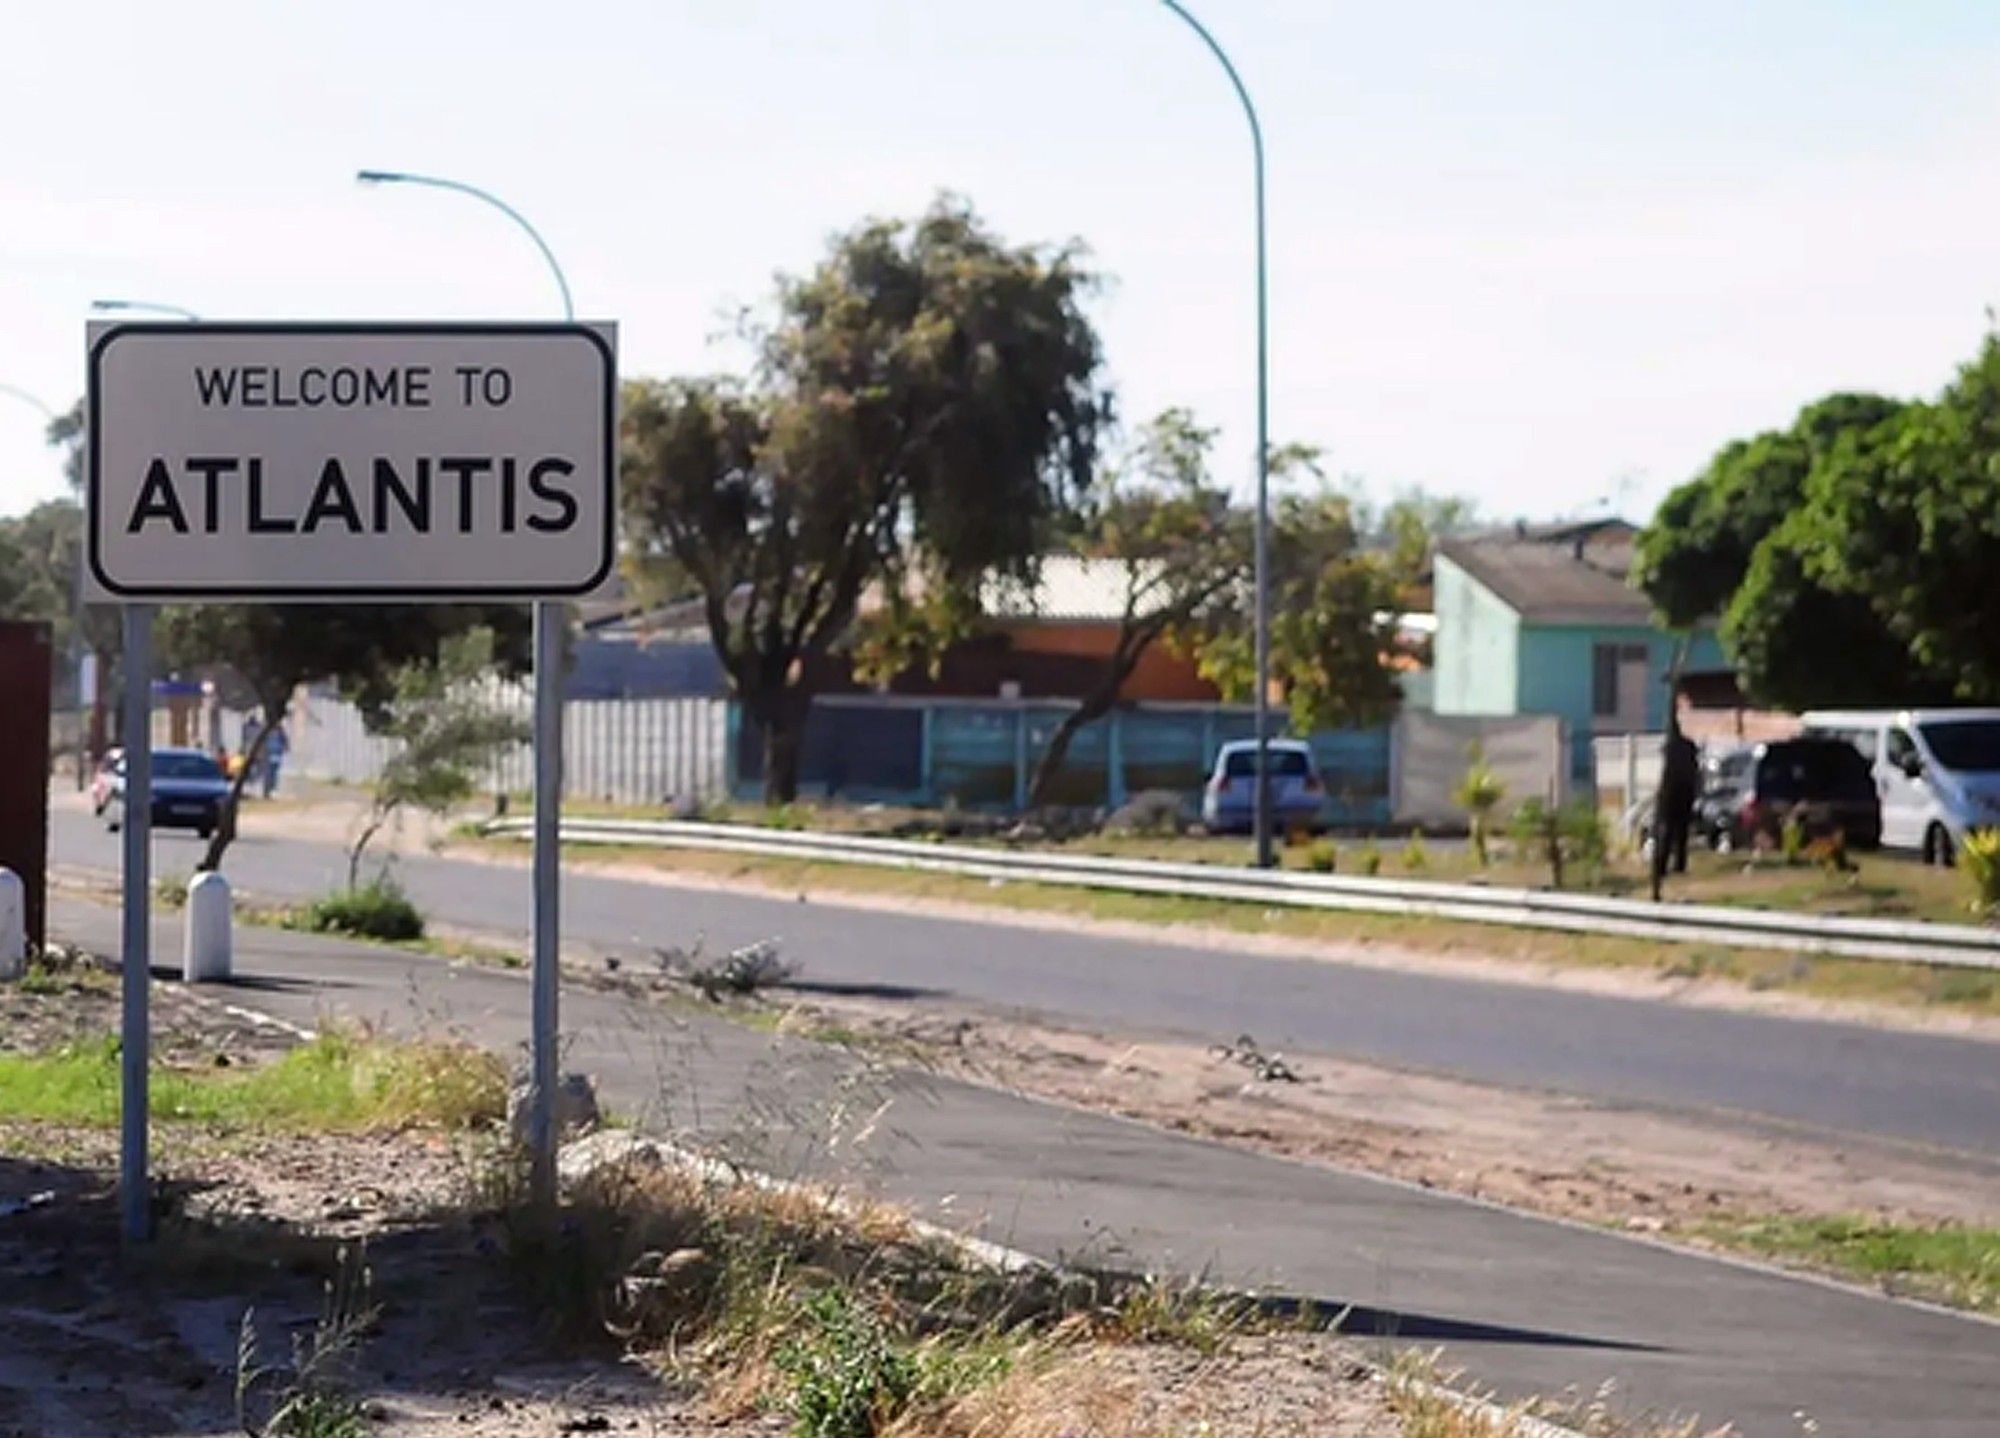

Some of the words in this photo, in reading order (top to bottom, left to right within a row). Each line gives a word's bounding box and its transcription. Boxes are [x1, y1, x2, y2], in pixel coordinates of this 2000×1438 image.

[195, 366, 431, 407] WELCOME
[455, 367, 512, 407] TO
[126, 456, 579, 536] ATLANTIS
